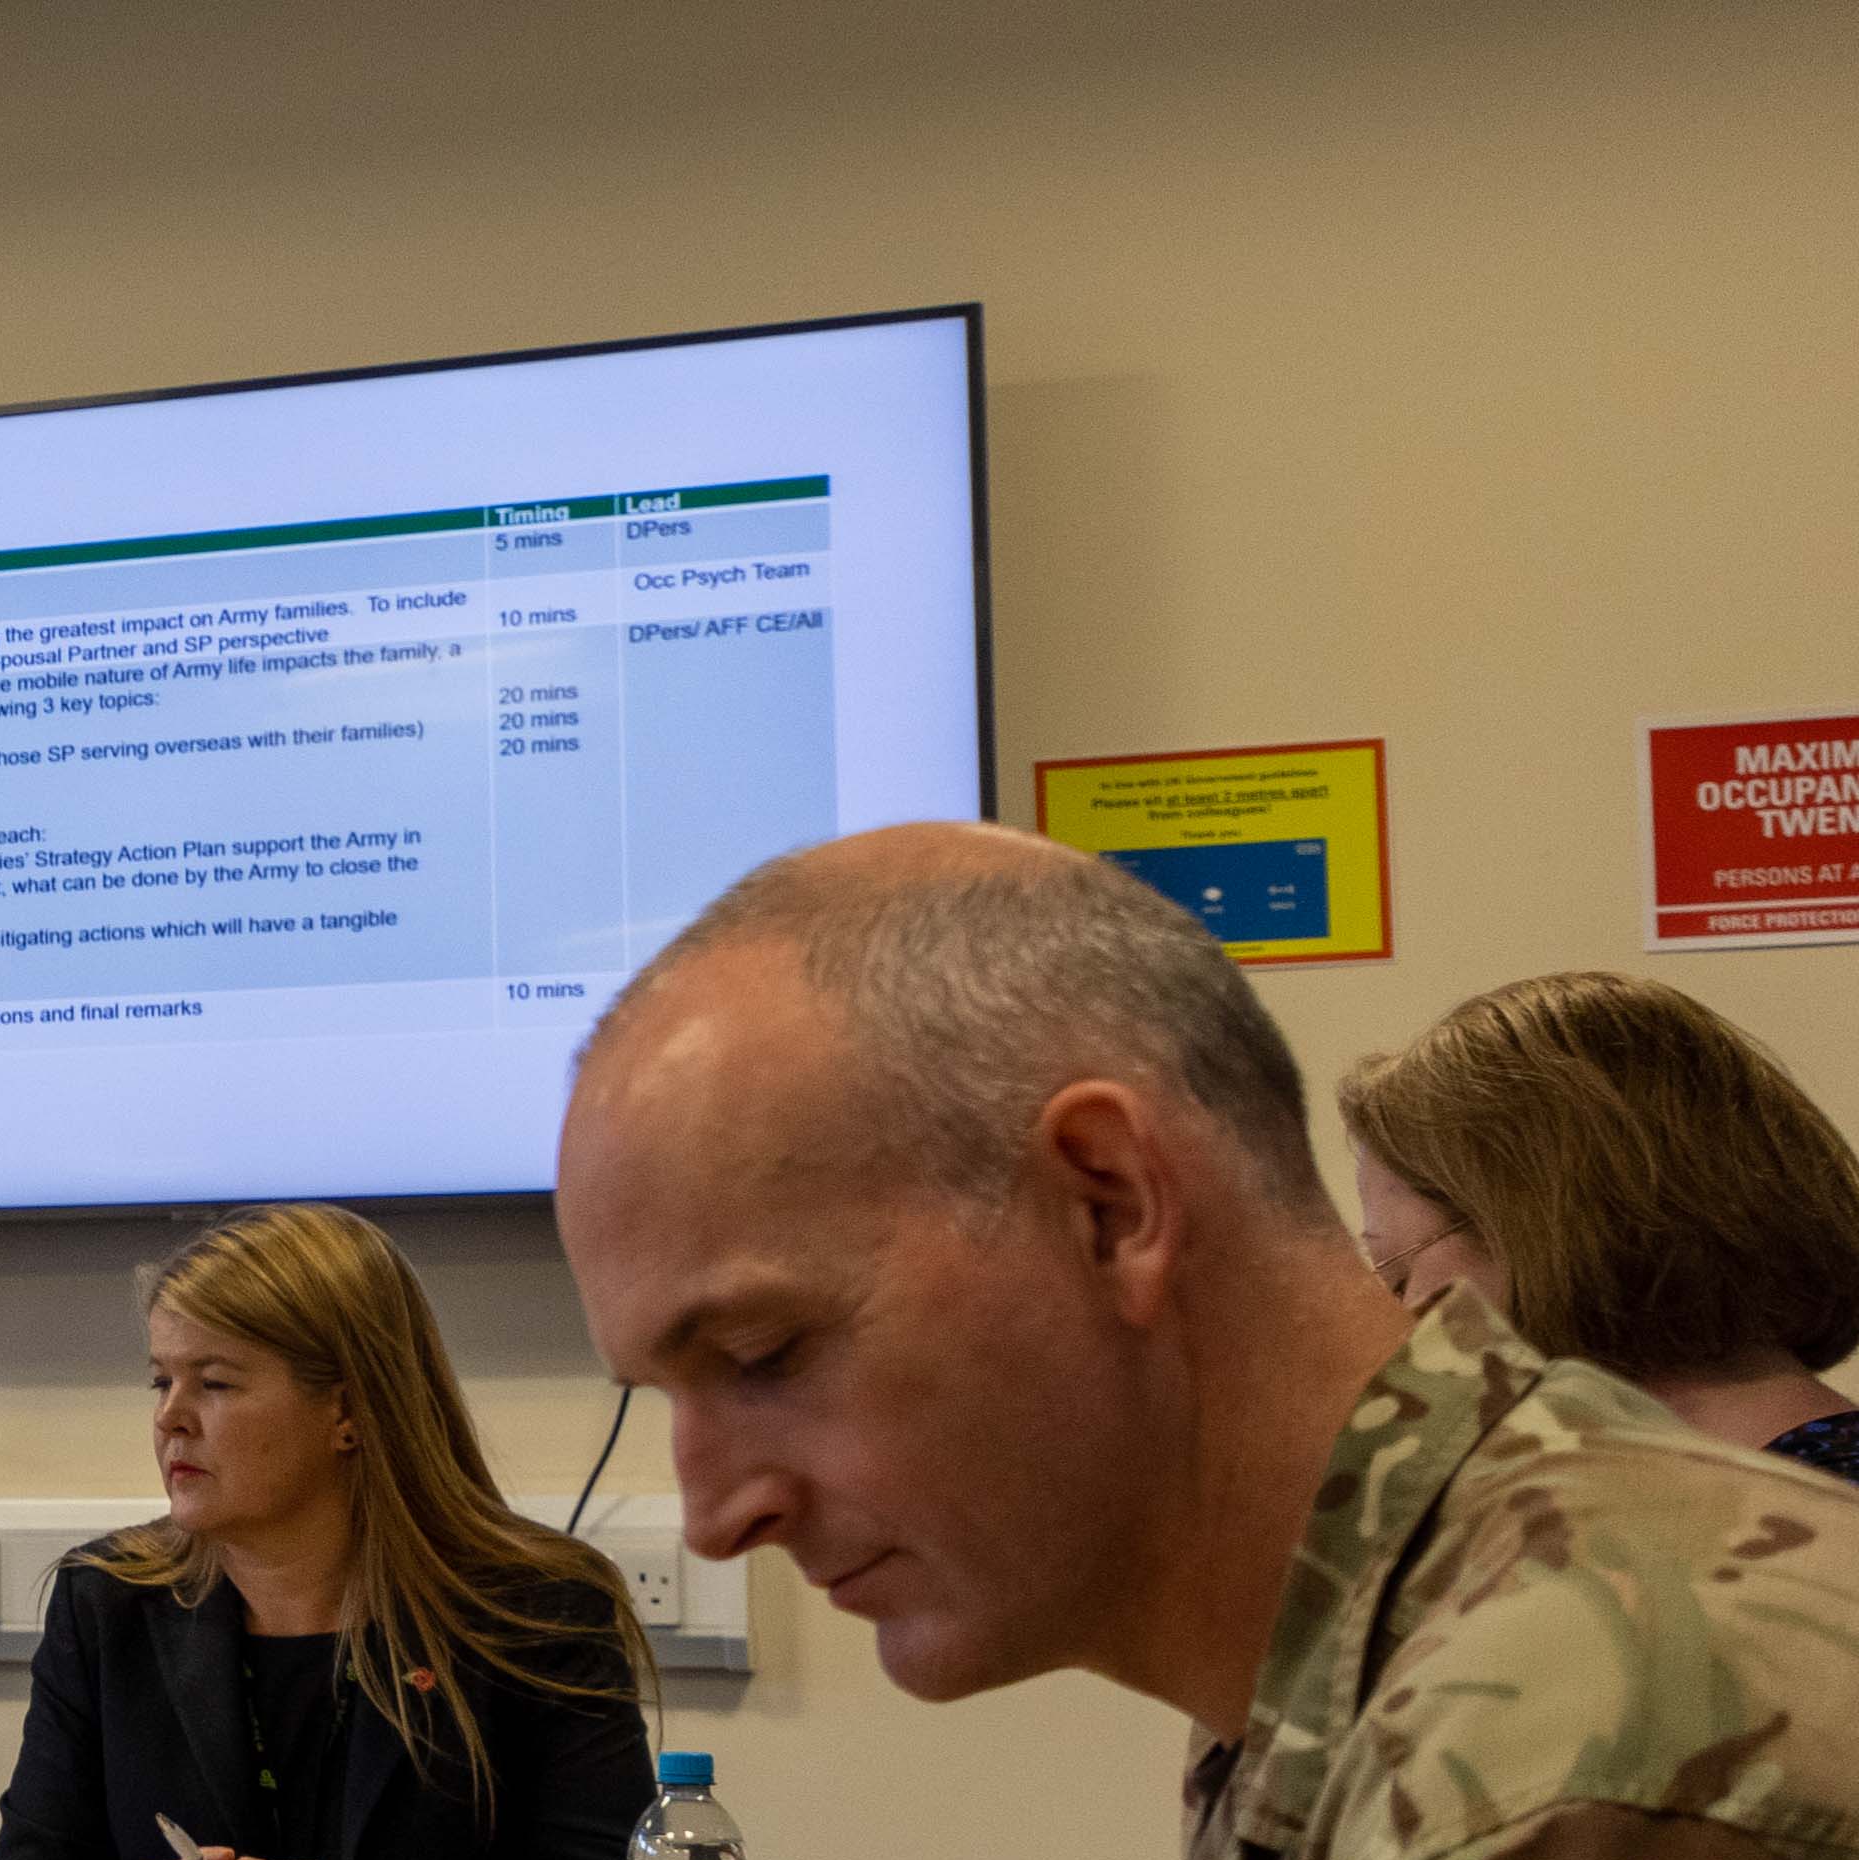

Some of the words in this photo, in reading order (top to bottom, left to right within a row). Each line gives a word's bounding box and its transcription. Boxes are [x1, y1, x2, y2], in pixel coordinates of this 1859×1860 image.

[495, 503, 570, 526] Timing
[625, 492, 681, 514] Lead
[495, 532, 509, 552] 5
[514, 528, 564, 550] mins
[626, 517, 692, 541] DPers
[634, 570, 676, 592] Occ
[681, 564, 746, 592] Psych
[753, 559, 811, 582] Team
[5, 623, 34, 643] the
[39, 616, 116, 645] greatest
[121, 611, 184, 638] impact
[189, 612, 214, 628] on
[218, 604, 269, 630] Army
[274, 597, 354, 621] families.
[368, 593, 391, 613] To
[396, 587, 467, 611] include
[500, 609, 523, 629] 10
[528, 605, 578, 626] mins
[704, 616, 748, 638] AFF
[498, 685, 525, 705] 20
[530, 682, 580, 703] mins
[499, 711, 525, 730] 20
[530, 709, 580, 729] mins
[47, 745, 76, 765] SP
[80, 740, 149, 766] serving
[154, 737, 242, 757] overseas
[247, 731, 287, 751] with
[292, 728, 334, 748] their
[341, 722, 424, 749] families)
[500, 737, 526, 757] 20
[530, 734, 581, 755] mins
[1735, 739, 1859, 776] MAXIM
[1696, 773, 1859, 812] OCCUPAN
[1755, 806, 1859, 839] TWEN
[34, 846, 113, 872] Strategy
[117, 842, 177, 864] Action
[182, 839, 226, 860] Plan
[231, 835, 305, 861] support
[310, 832, 341, 852] the
[345, 829, 398, 854] Army
[403, 828, 422, 847] in
[1713, 865, 1814, 888] PERSONS
[1818, 863, 1844, 883] AT
[1707, 913, 1760, 931] FORCE
[1766, 908, 1859, 929] PROTECTIO
[508, 982, 531, 1001] 10
[536, 981, 586, 1000] mins
[39, 1005, 75, 1025] and
[80, 1003, 120, 1023] final
[125, 999, 203, 1021] remarks
